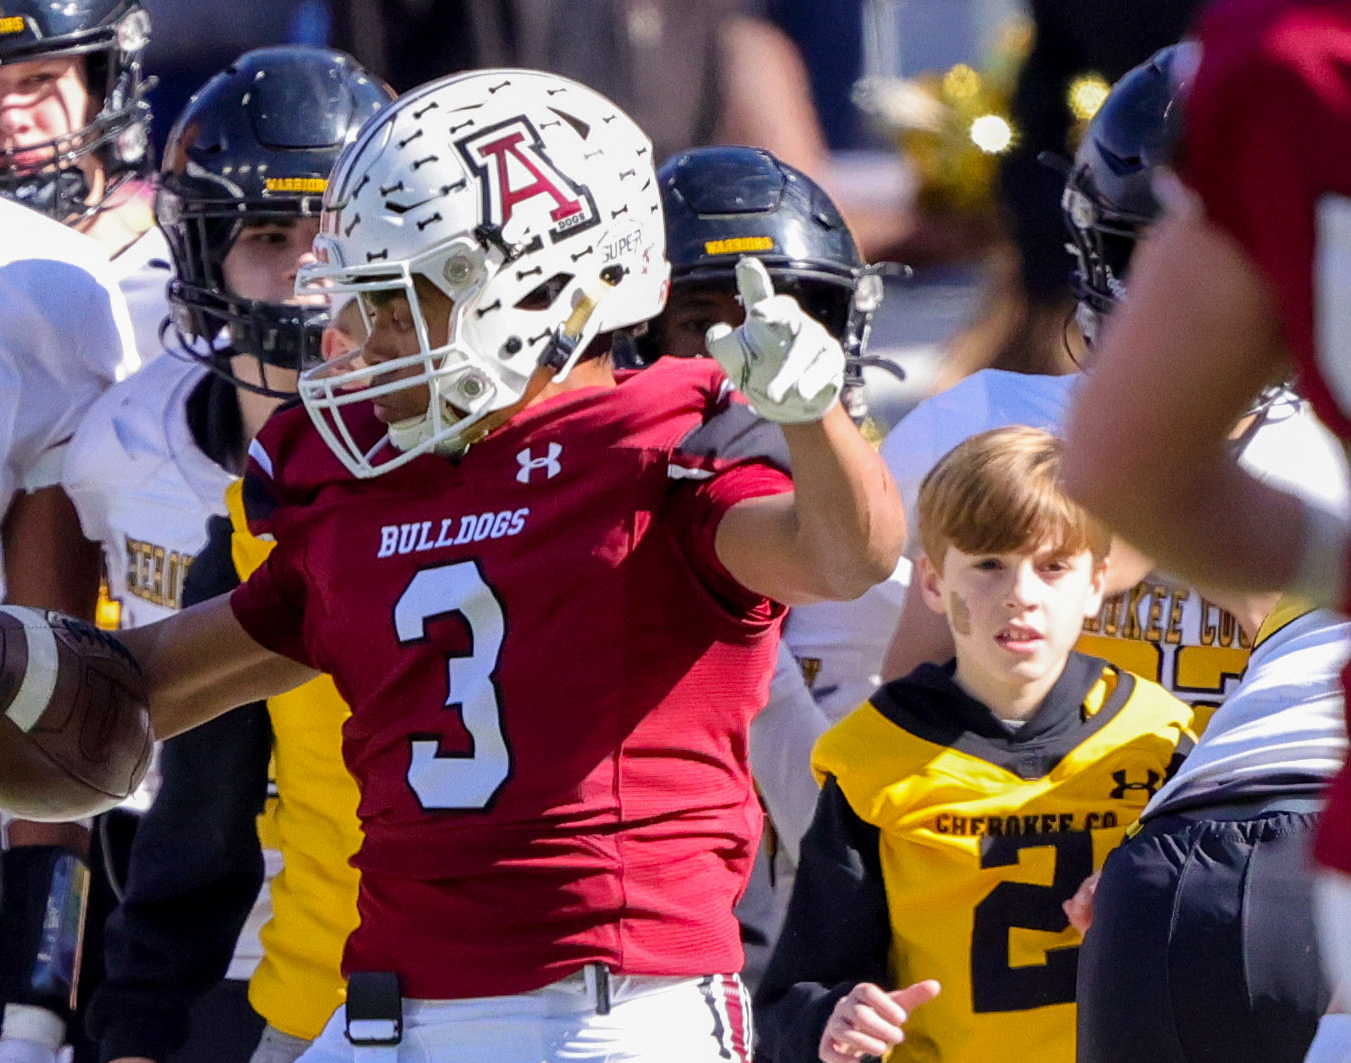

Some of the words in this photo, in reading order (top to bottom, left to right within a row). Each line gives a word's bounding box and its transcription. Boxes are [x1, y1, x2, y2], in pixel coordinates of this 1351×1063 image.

[454, 115, 600, 248] A
[558, 212, 586, 230] DOGS
[377, 508, 530, 558] BULLDOGS
[394, 559, 511, 810] 3
[936, 813, 1074, 836] CHEROKEE
[971, 830, 1093, 1014] 2
